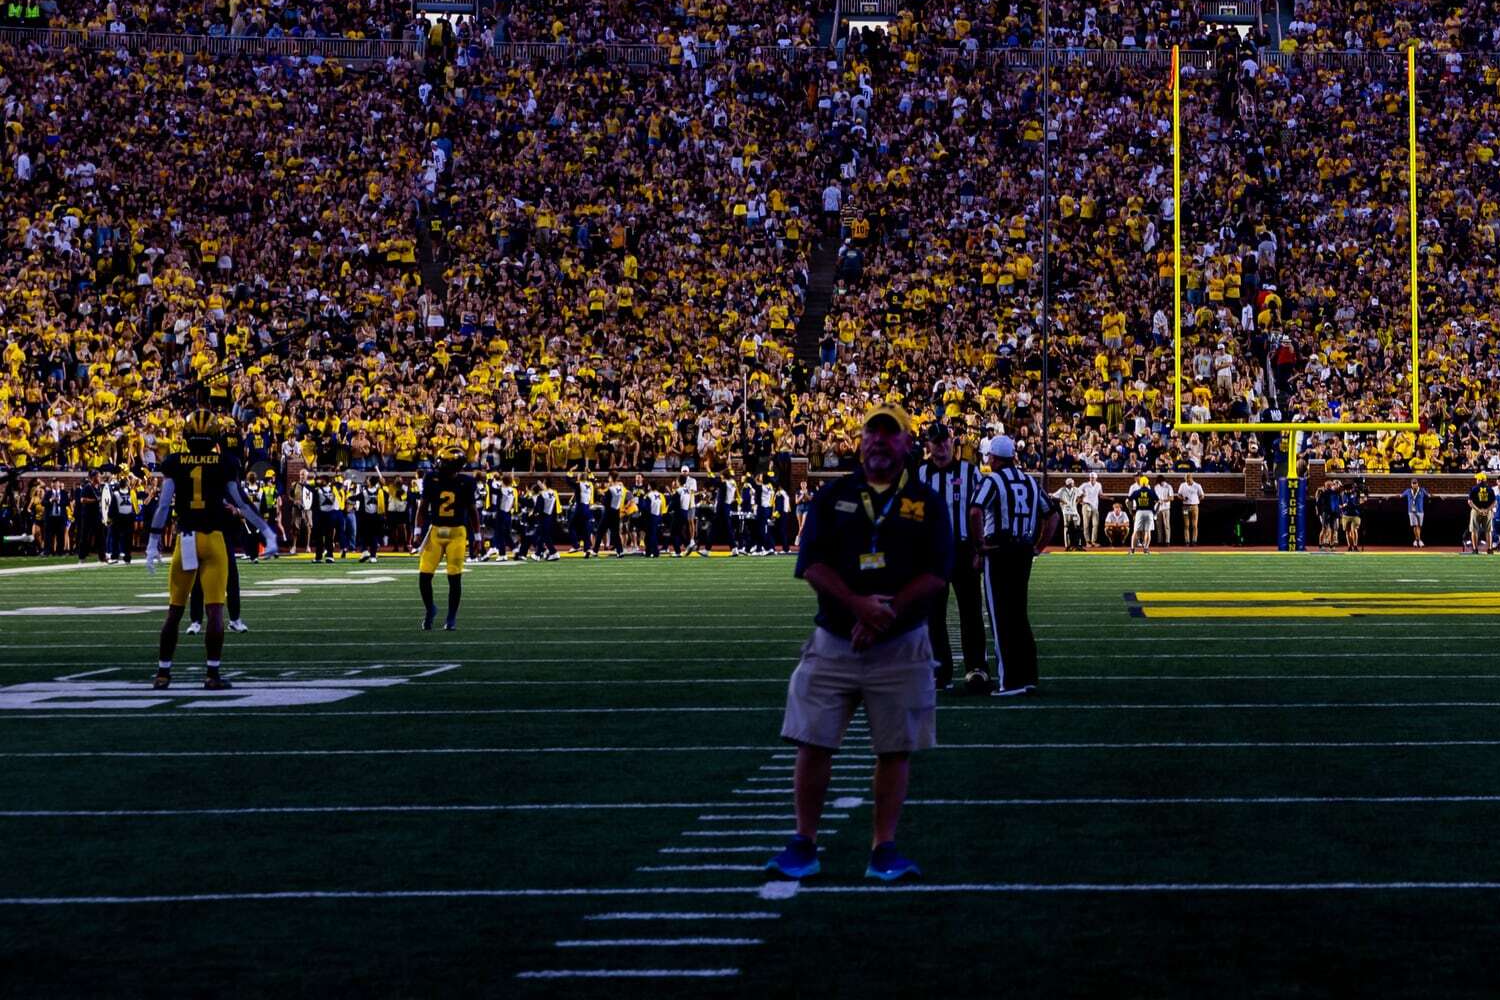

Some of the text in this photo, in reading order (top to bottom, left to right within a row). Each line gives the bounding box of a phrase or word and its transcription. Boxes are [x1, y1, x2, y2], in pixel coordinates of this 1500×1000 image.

[179, 455, 220, 465] WALKER
[189, 465, 206, 510] 1
[1010, 482, 1030, 515] R
[438, 490, 457, 518] 2
[897, 496, 926, 522] M
[1287, 479, 1299, 552] MICHIGAN
